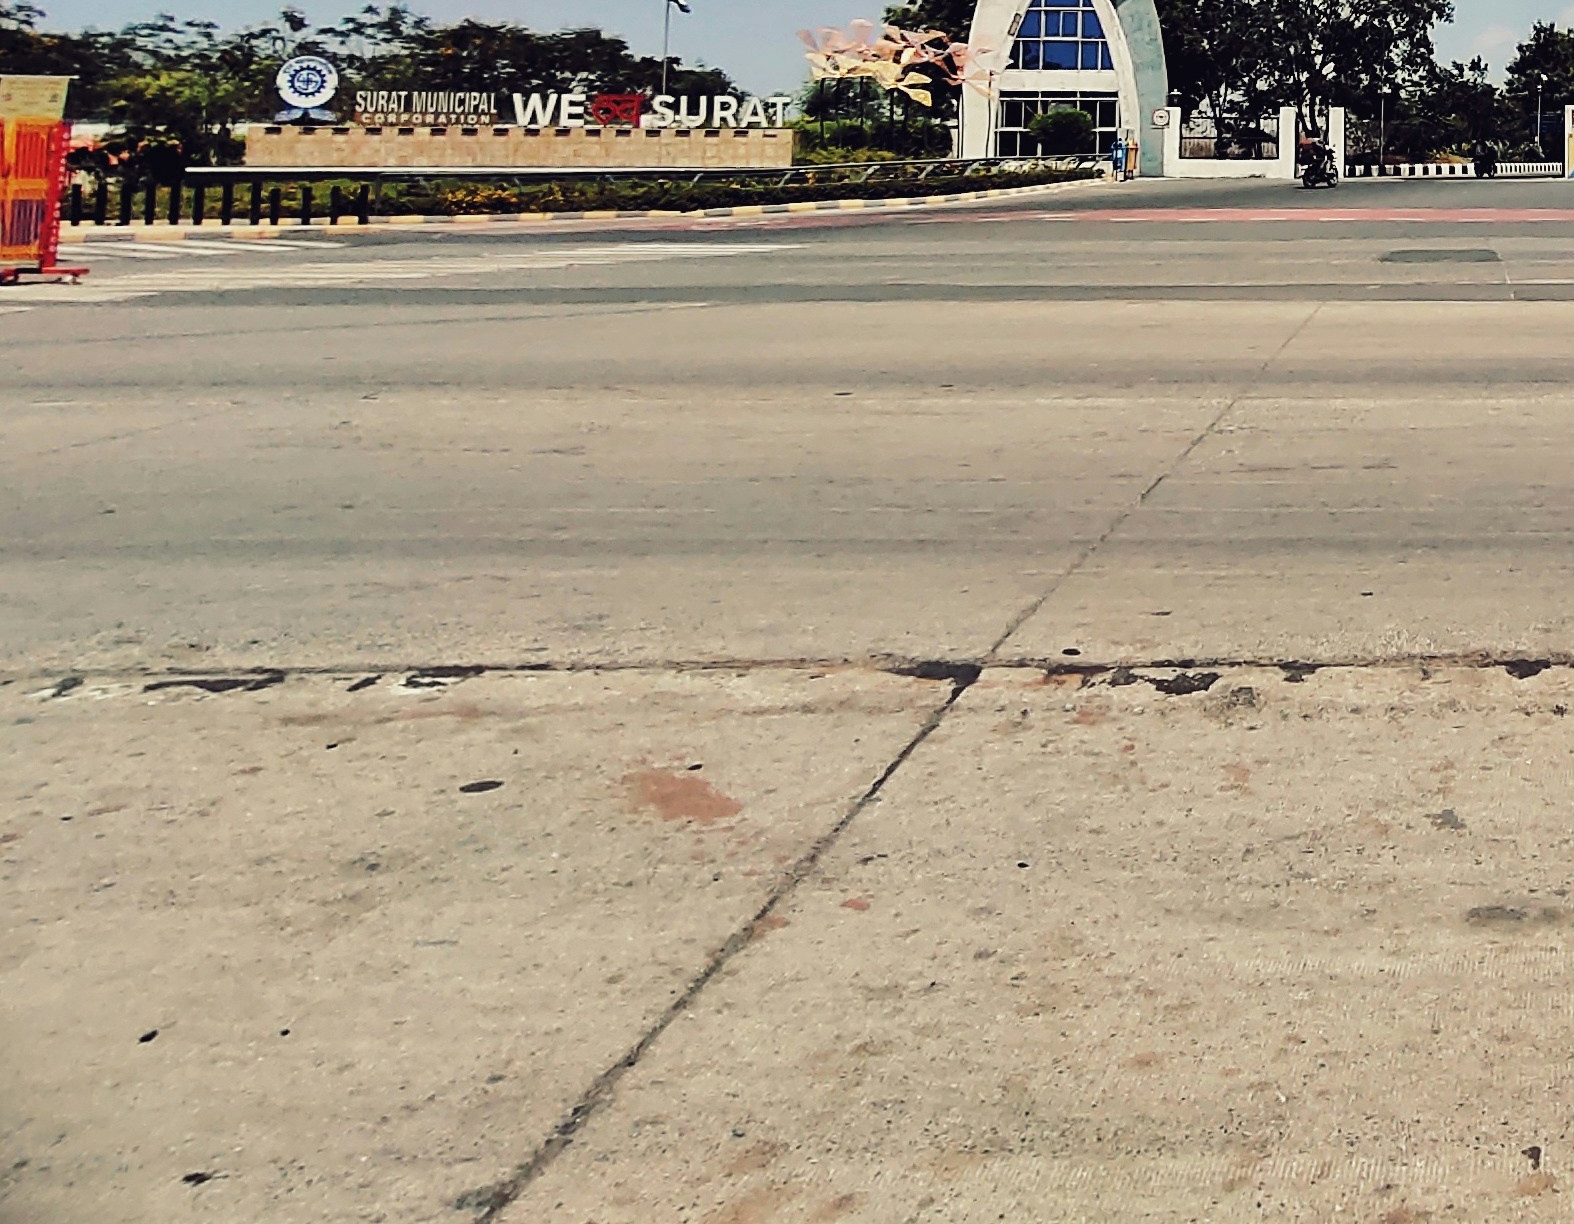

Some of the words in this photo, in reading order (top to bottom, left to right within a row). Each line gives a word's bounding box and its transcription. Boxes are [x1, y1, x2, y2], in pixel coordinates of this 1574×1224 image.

[355, 90, 409, 113] SURAT
[412, 91, 498, 114] MUNICIPAL
[512, 92, 587, 127] WE
[652, 94, 792, 128] SURAT
[361, 113, 491, 124] CORPORATION
